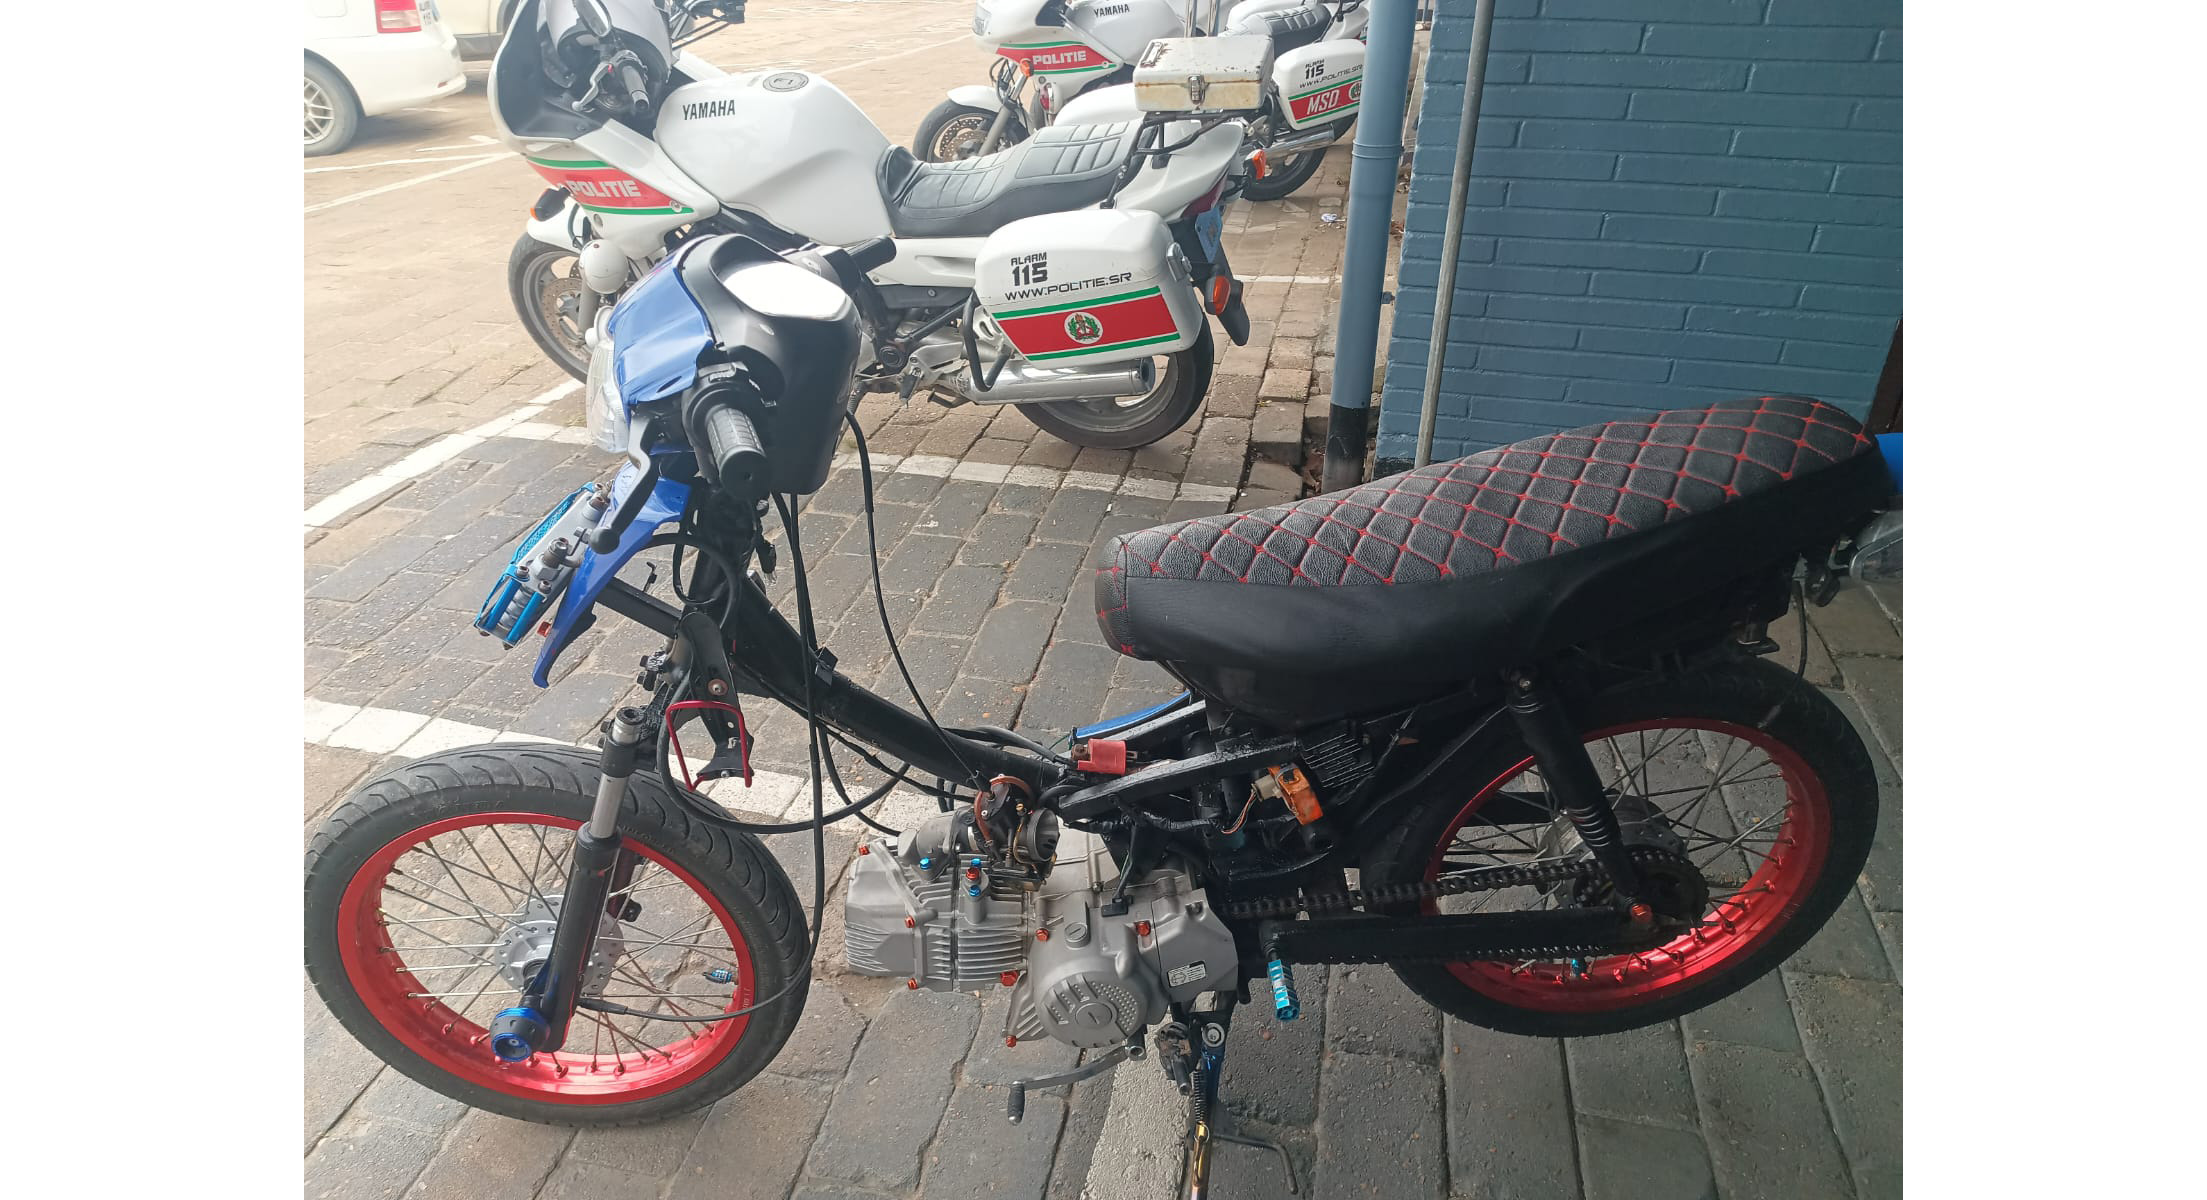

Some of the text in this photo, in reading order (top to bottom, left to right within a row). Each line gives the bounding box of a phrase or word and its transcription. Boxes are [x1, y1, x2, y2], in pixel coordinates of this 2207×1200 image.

[1094, 4, 1130, 17] YAMAHA
[1033, 50, 1086, 65] POLITIE
[1305, 64, 1324, 79] 115
[682, 99, 736, 121] YAMAHA
[1307, 89, 1340, 115] MSD
[566, 180, 641, 198] POLITIE
[1011, 252, 1047, 266] ALARM
[1012, 261, 1048, 286] 115
[1005, 272, 1132, 301] WWW.POLITIE.SR
